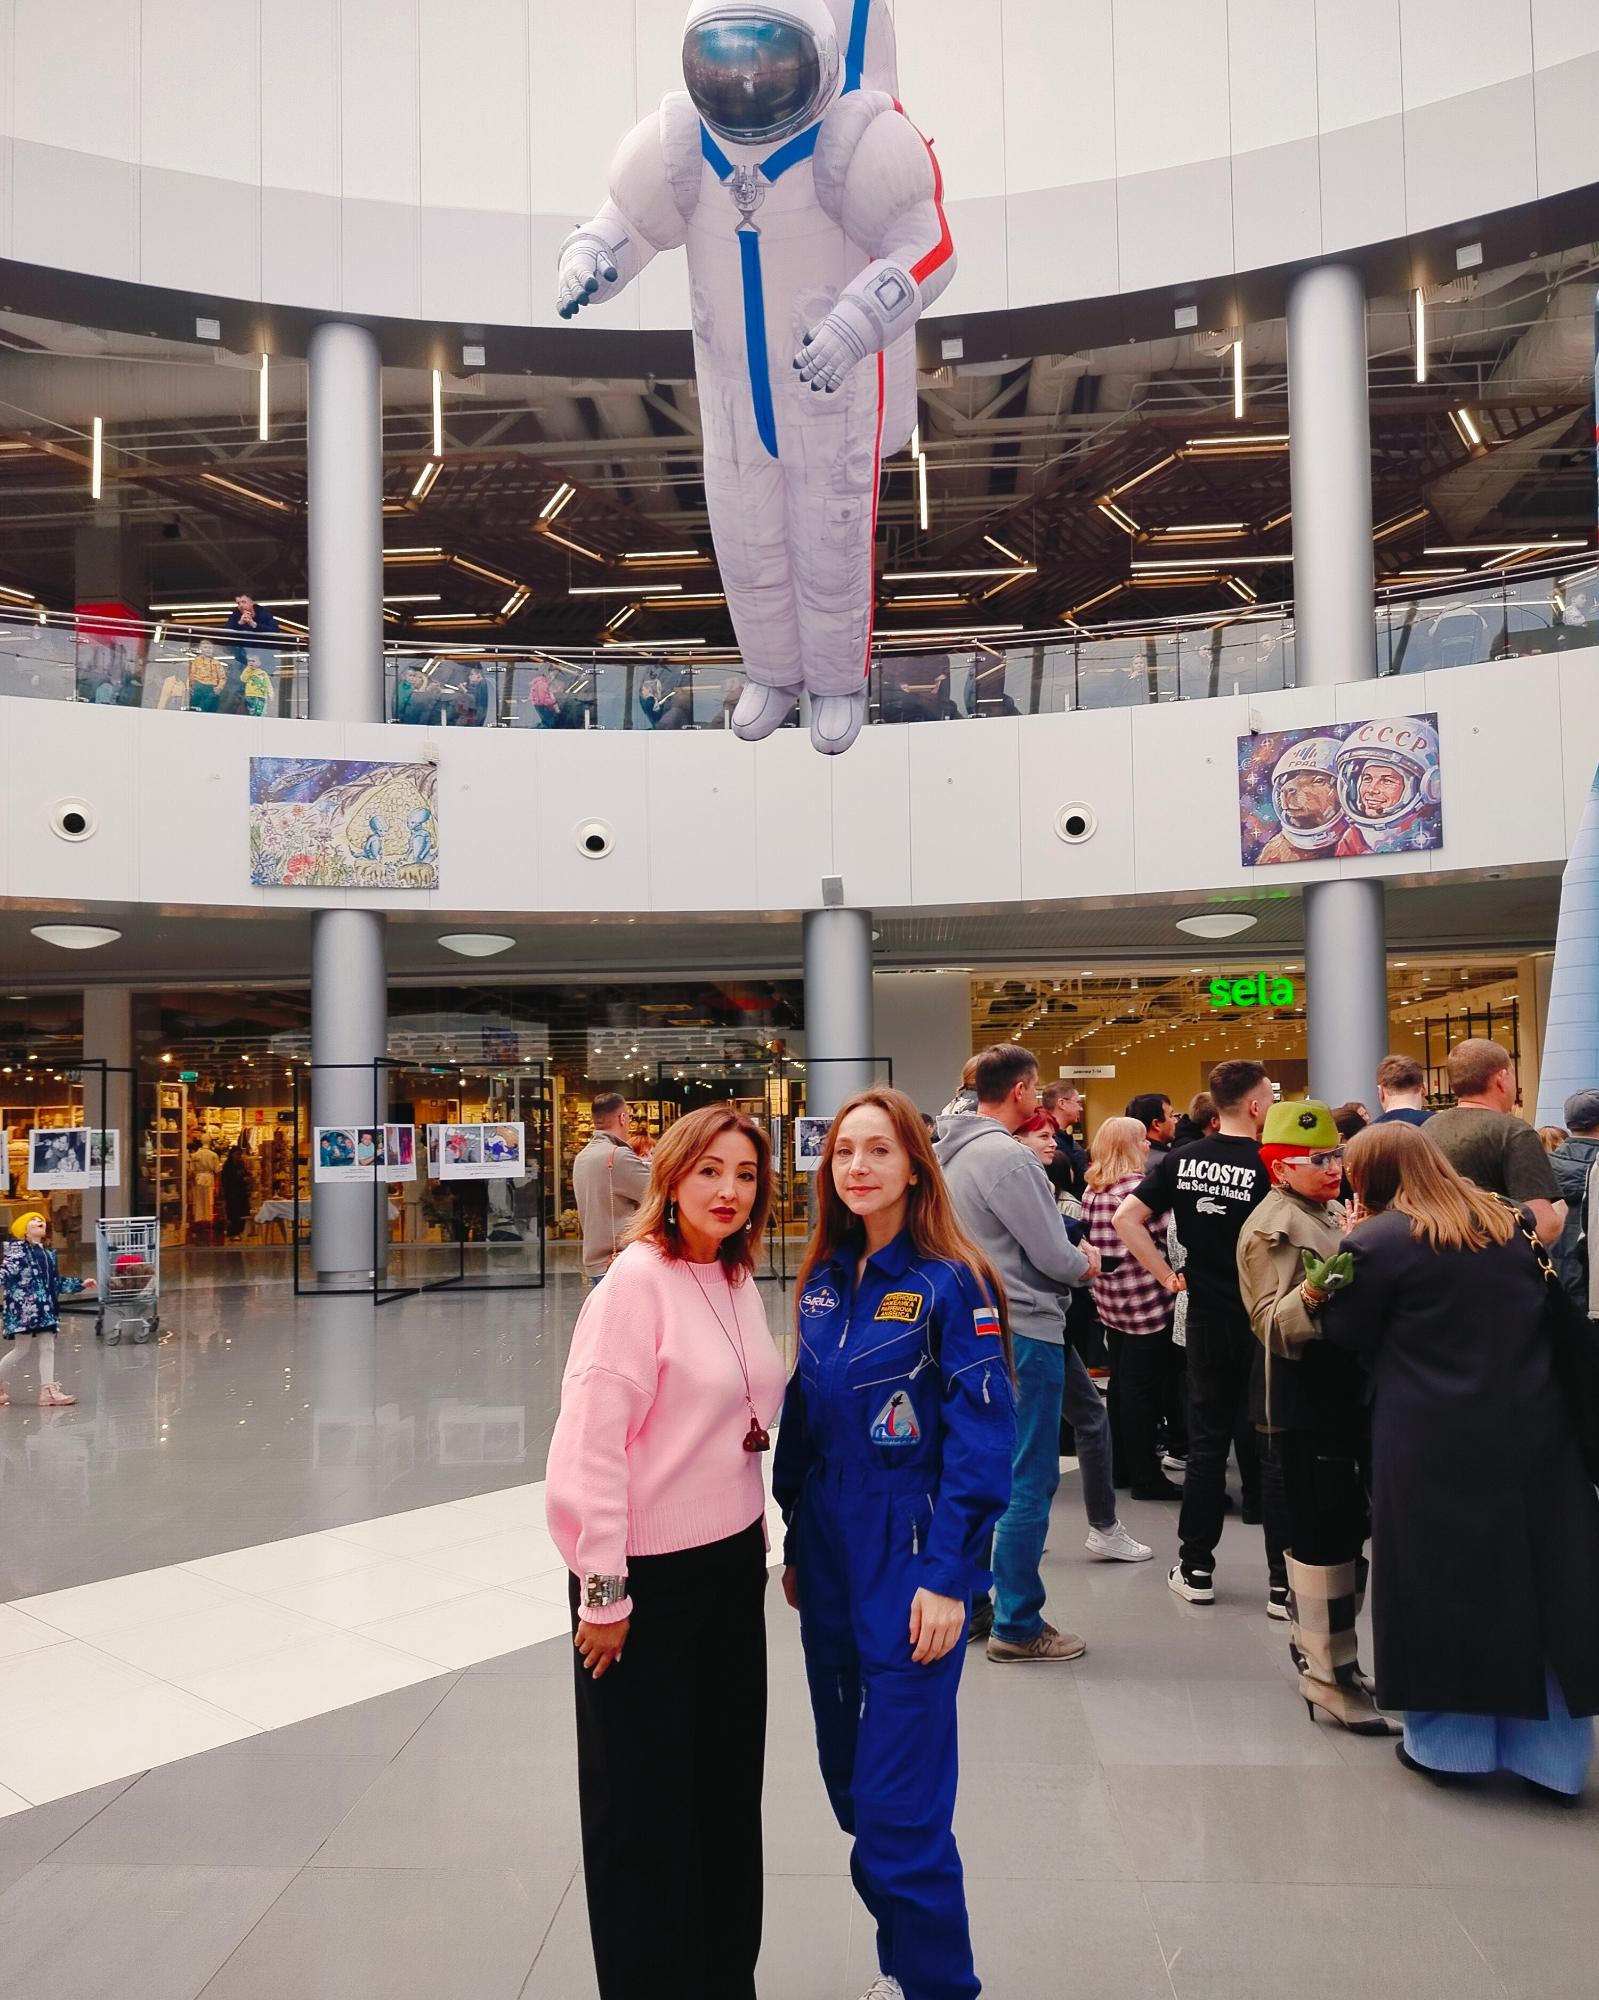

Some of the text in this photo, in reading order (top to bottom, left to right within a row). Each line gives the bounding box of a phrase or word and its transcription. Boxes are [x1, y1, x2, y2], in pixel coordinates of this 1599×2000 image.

[1359, 725, 1428, 752] СССР
[1288, 760, 1317, 768] ГРАД
[1208, 970, 1294, 1007] sela
[1177, 1158, 1257, 1189] LACOSTE
[1176, 1178, 1251, 1202] Jeu Set et Match
